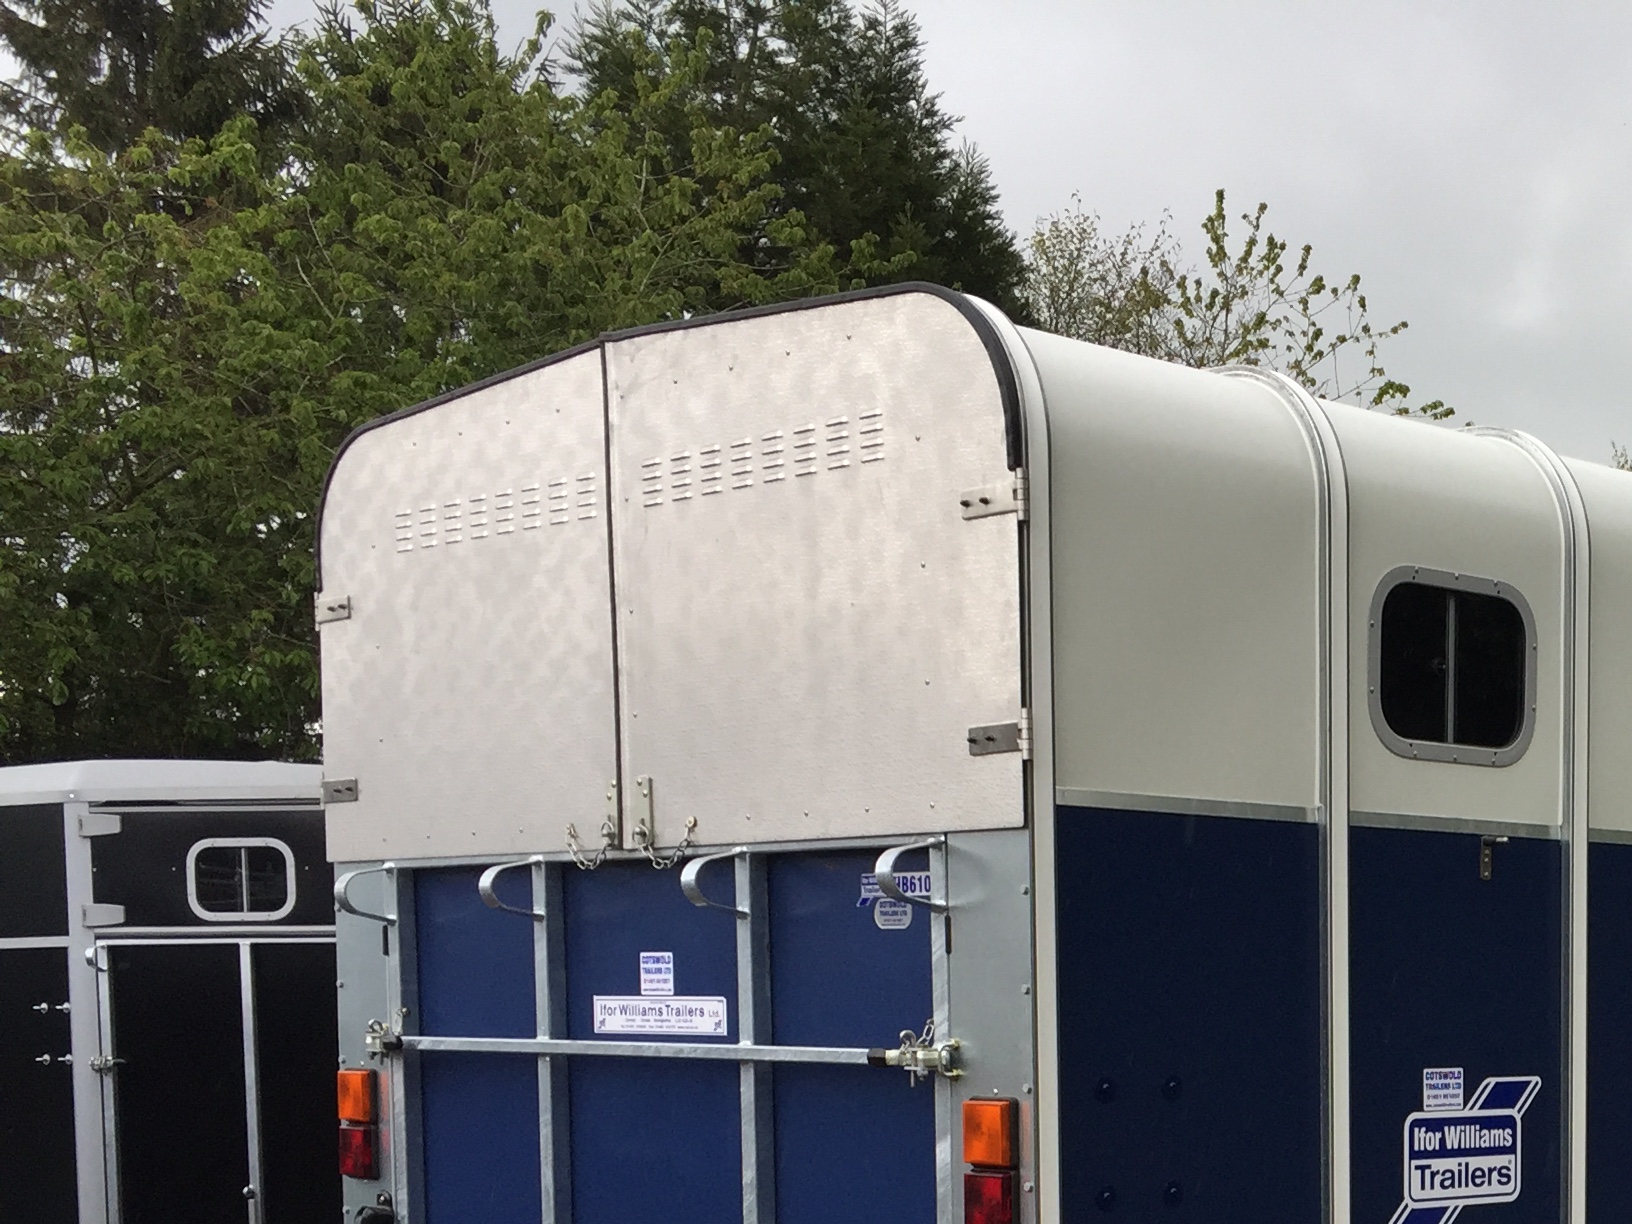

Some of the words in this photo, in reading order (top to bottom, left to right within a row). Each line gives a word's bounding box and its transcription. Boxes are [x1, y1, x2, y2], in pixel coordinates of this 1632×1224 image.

[600, 1003, 617, 1016] Ifor
[618, 1003, 664, 1017] Williams
[665, 1004, 705, 1018] Trailers
[1425, 1071, 1462, 1080] COTSWOLD
[1413, 1126, 1442, 1152] Ifor
[1443, 1124, 1513, 1150] Williams
[1414, 1161, 1512, 1191] Trailers
